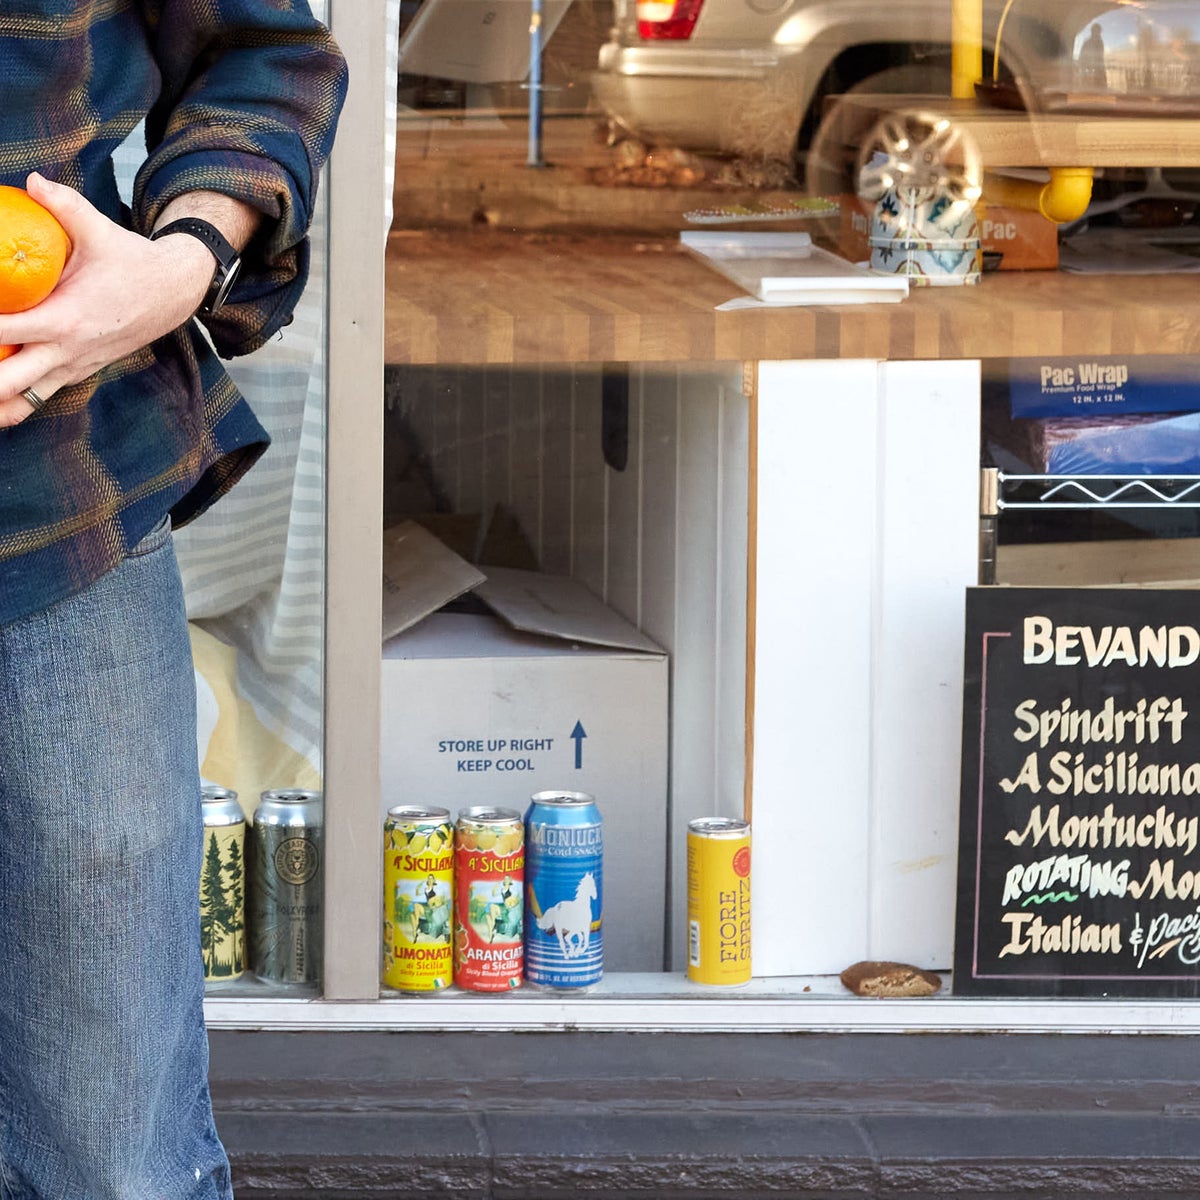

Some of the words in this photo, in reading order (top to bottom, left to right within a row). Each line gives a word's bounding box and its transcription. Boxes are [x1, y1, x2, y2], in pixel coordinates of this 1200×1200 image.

[982, 220, 1017, 241] Pac
[1040, 366, 1075, 387] Pac
[1078, 363, 1128, 387] Wrap
[1076, 384, 1096, 392] Food
[1023, 615, 1200, 668] BEVAND
[438, 740, 484, 753] STORE
[487, 740, 507, 752] UP
[510, 738, 554, 751] RIGHT
[1013, 696, 1189, 749] Spindrift
[457, 760, 493, 772] KEEP
[495, 759, 535, 771] COOL
[998, 751, 1042, 794] A
[1046, 750, 1200, 797] Siciliana
[1004, 802, 1199, 857] Montucky
[1001, 853, 1132, 907] ROTATING
[720, 890, 737, 963] FIORE
[998, 912, 1123, 959] Italian
[491, 959, 519, 971] Sicilia
